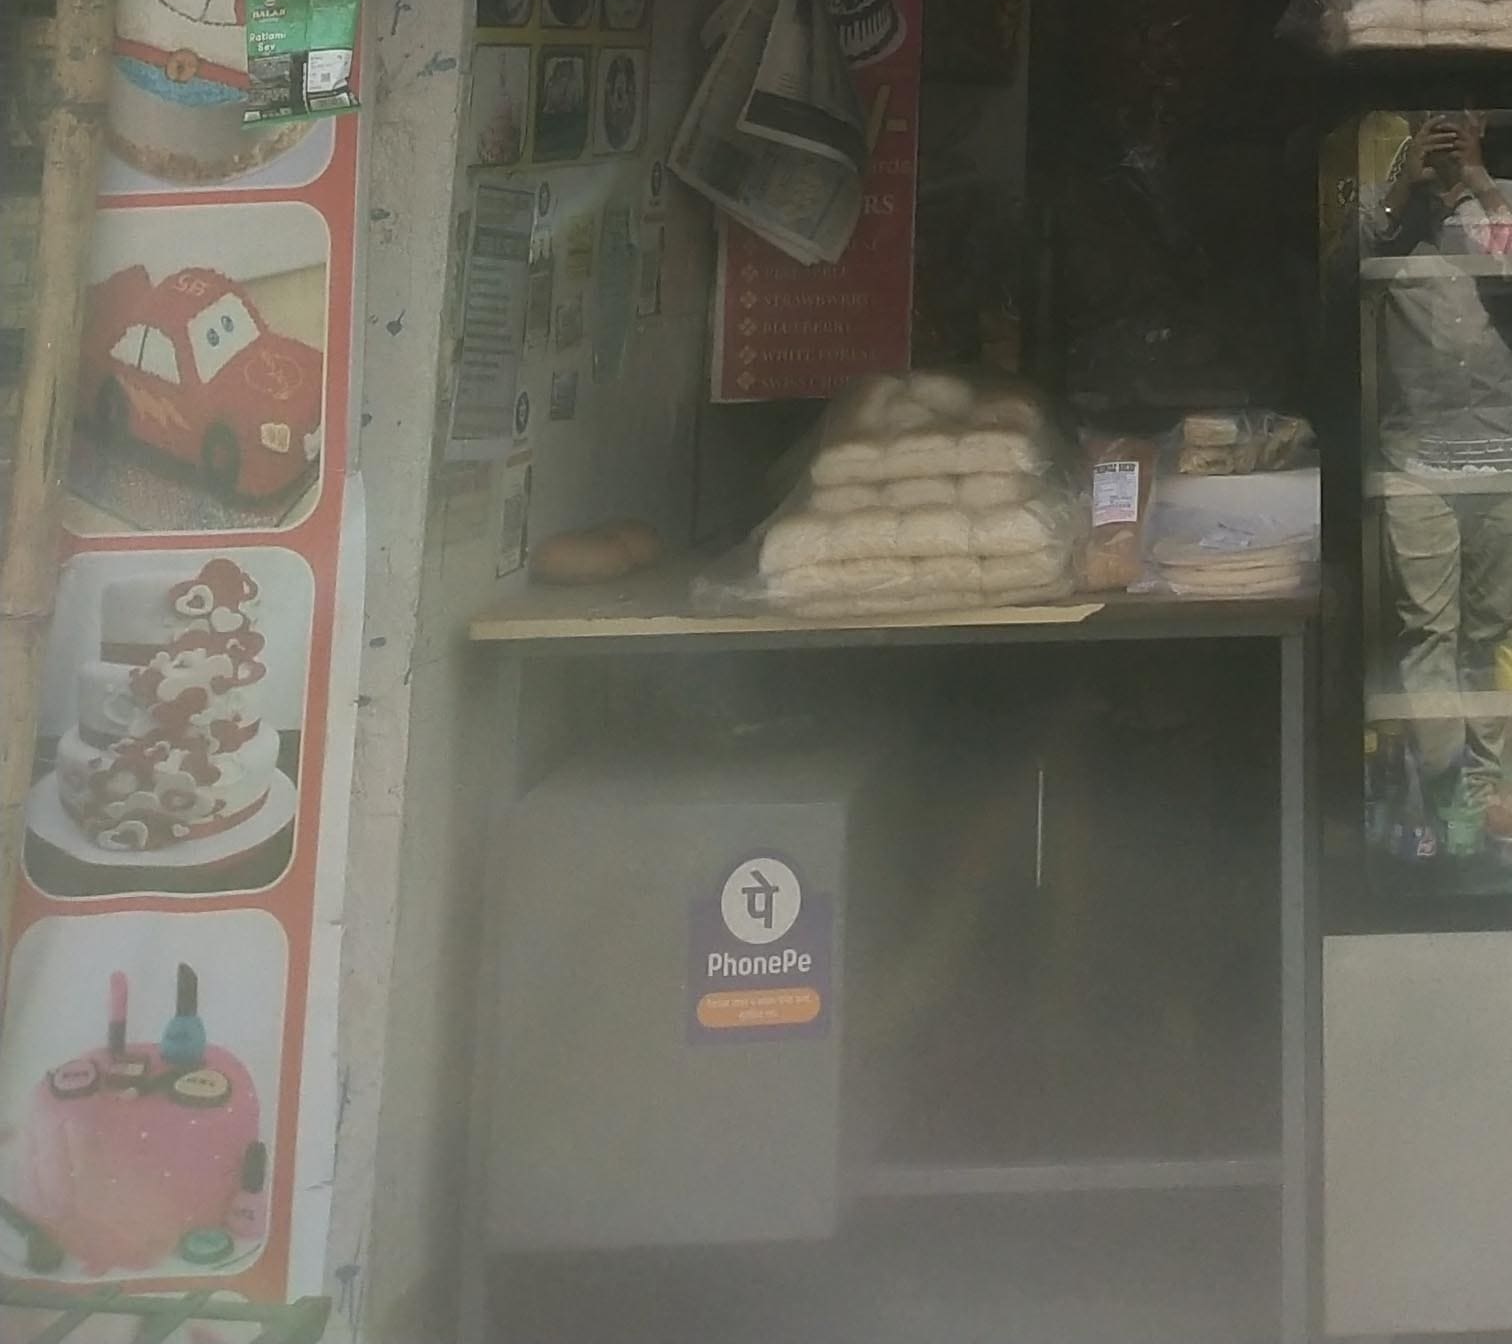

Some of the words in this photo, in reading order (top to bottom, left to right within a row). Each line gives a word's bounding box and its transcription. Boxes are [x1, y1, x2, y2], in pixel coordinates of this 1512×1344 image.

[258, 42, 275, 52] Sev
[742, 869, 779, 929] पे
[707, 949, 811, 977] PhonePe
